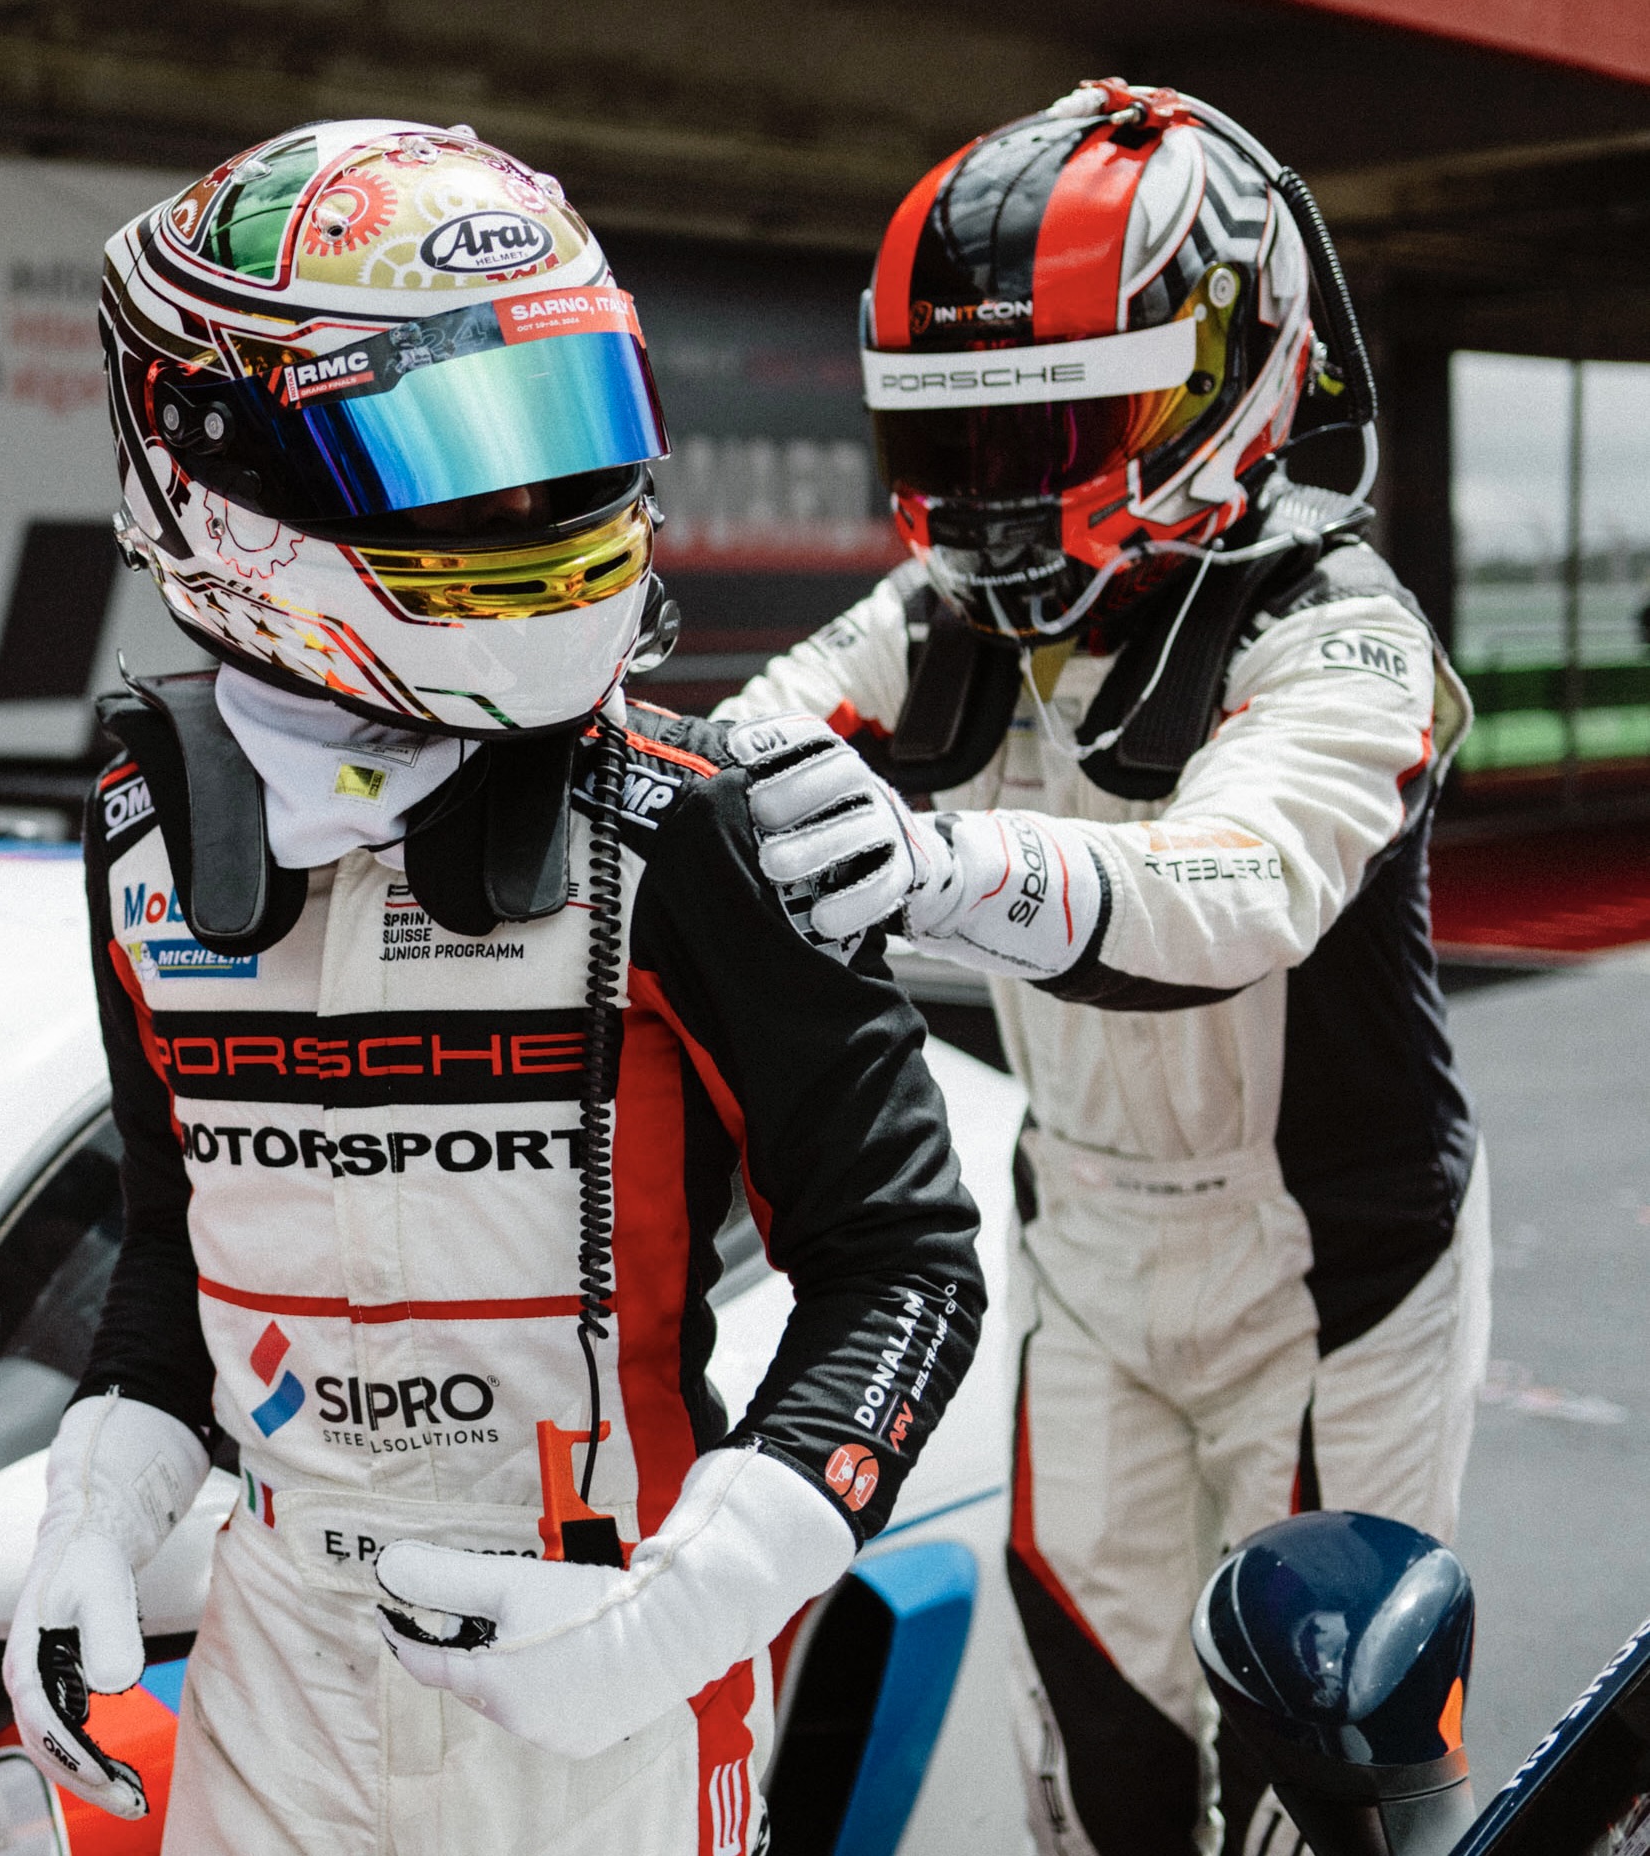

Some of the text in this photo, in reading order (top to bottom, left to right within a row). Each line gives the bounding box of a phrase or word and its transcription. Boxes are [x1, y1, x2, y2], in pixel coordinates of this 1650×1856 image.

[435, 218, 540, 267] Arai
[474, 251, 525, 267] HELMET
[510, 296, 594, 321] SARNO,
[933, 300, 1034, 324] INITCON
[297, 351, 369, 386] RMC
[881, 362, 1086, 392] PORSCHE
[1321, 640, 1408, 677] OMP
[104, 780, 152, 829] OM
[584, 771, 674, 816] MP
[124, 882, 184, 930] Mob
[379, 944, 525, 961] JUNIOR PROGRAMM
[382, 927, 433, 944] SUISSE
[854, 1291, 925, 1429] DONALAM
[910, 1313, 949, 1402] BELTRAME
[43, 1736, 78, 1773] OMP
